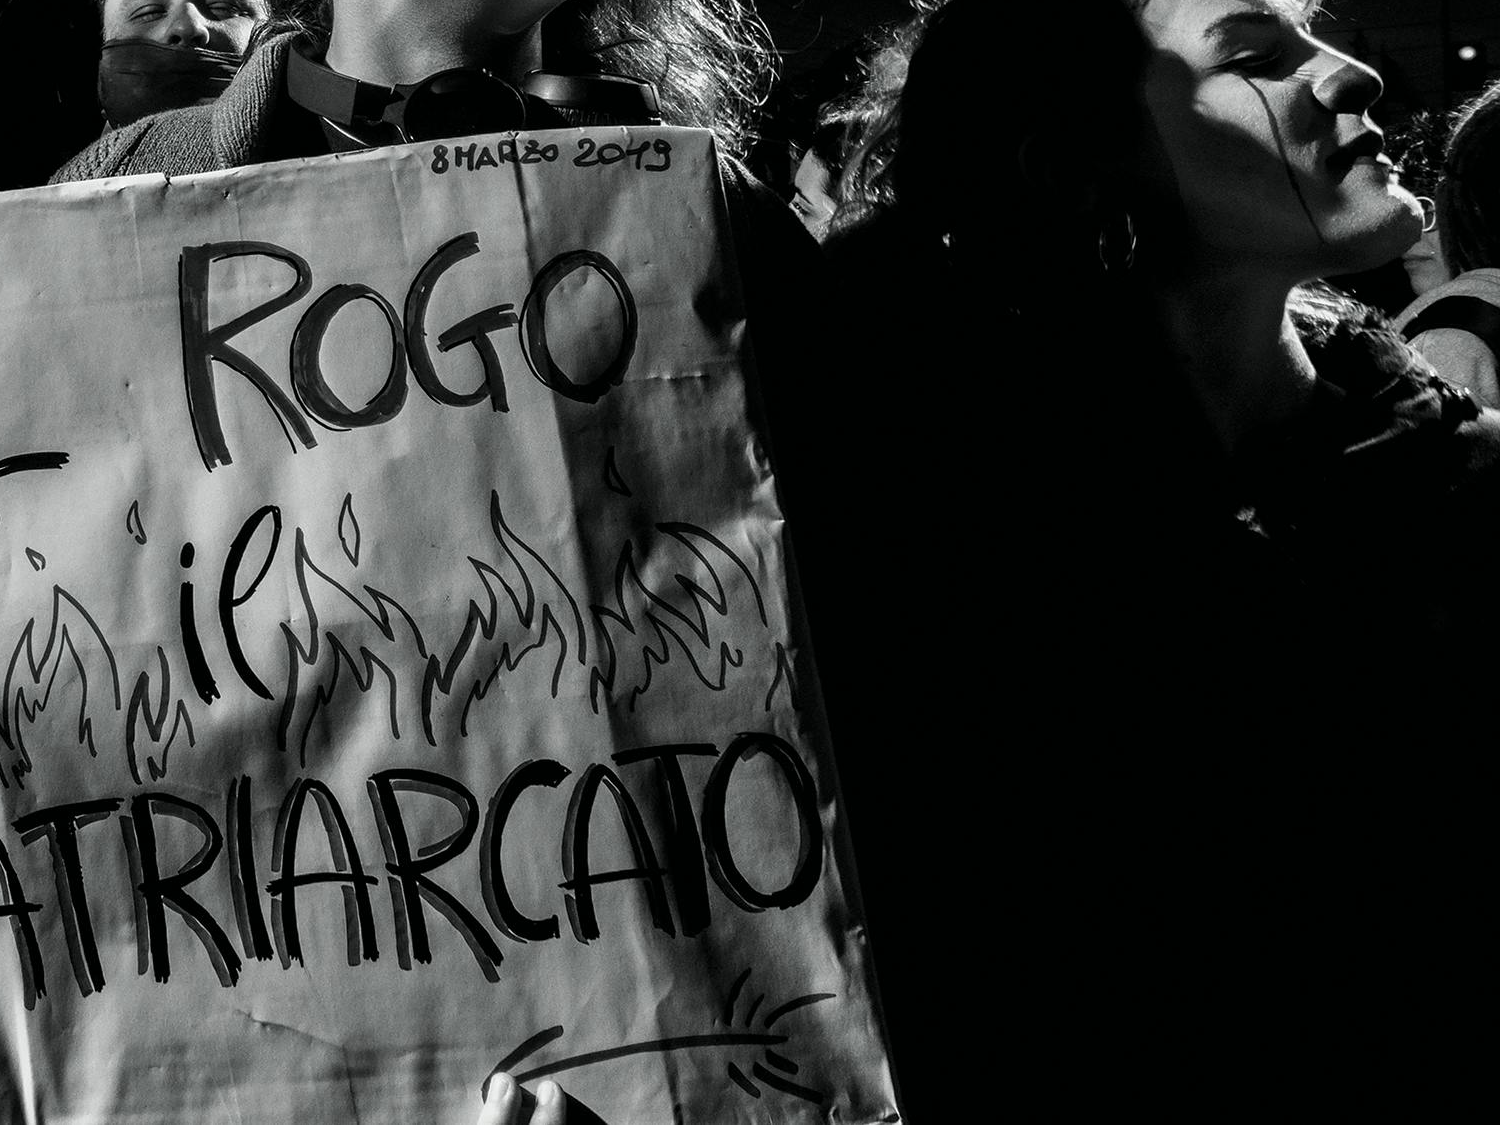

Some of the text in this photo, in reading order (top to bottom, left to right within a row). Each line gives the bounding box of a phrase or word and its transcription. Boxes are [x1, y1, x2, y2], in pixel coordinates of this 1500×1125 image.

[431, 138, 672, 174] 8 MARZO 2019
[178, 232, 638, 472] ROGO
[180, 505, 282, 704] il
